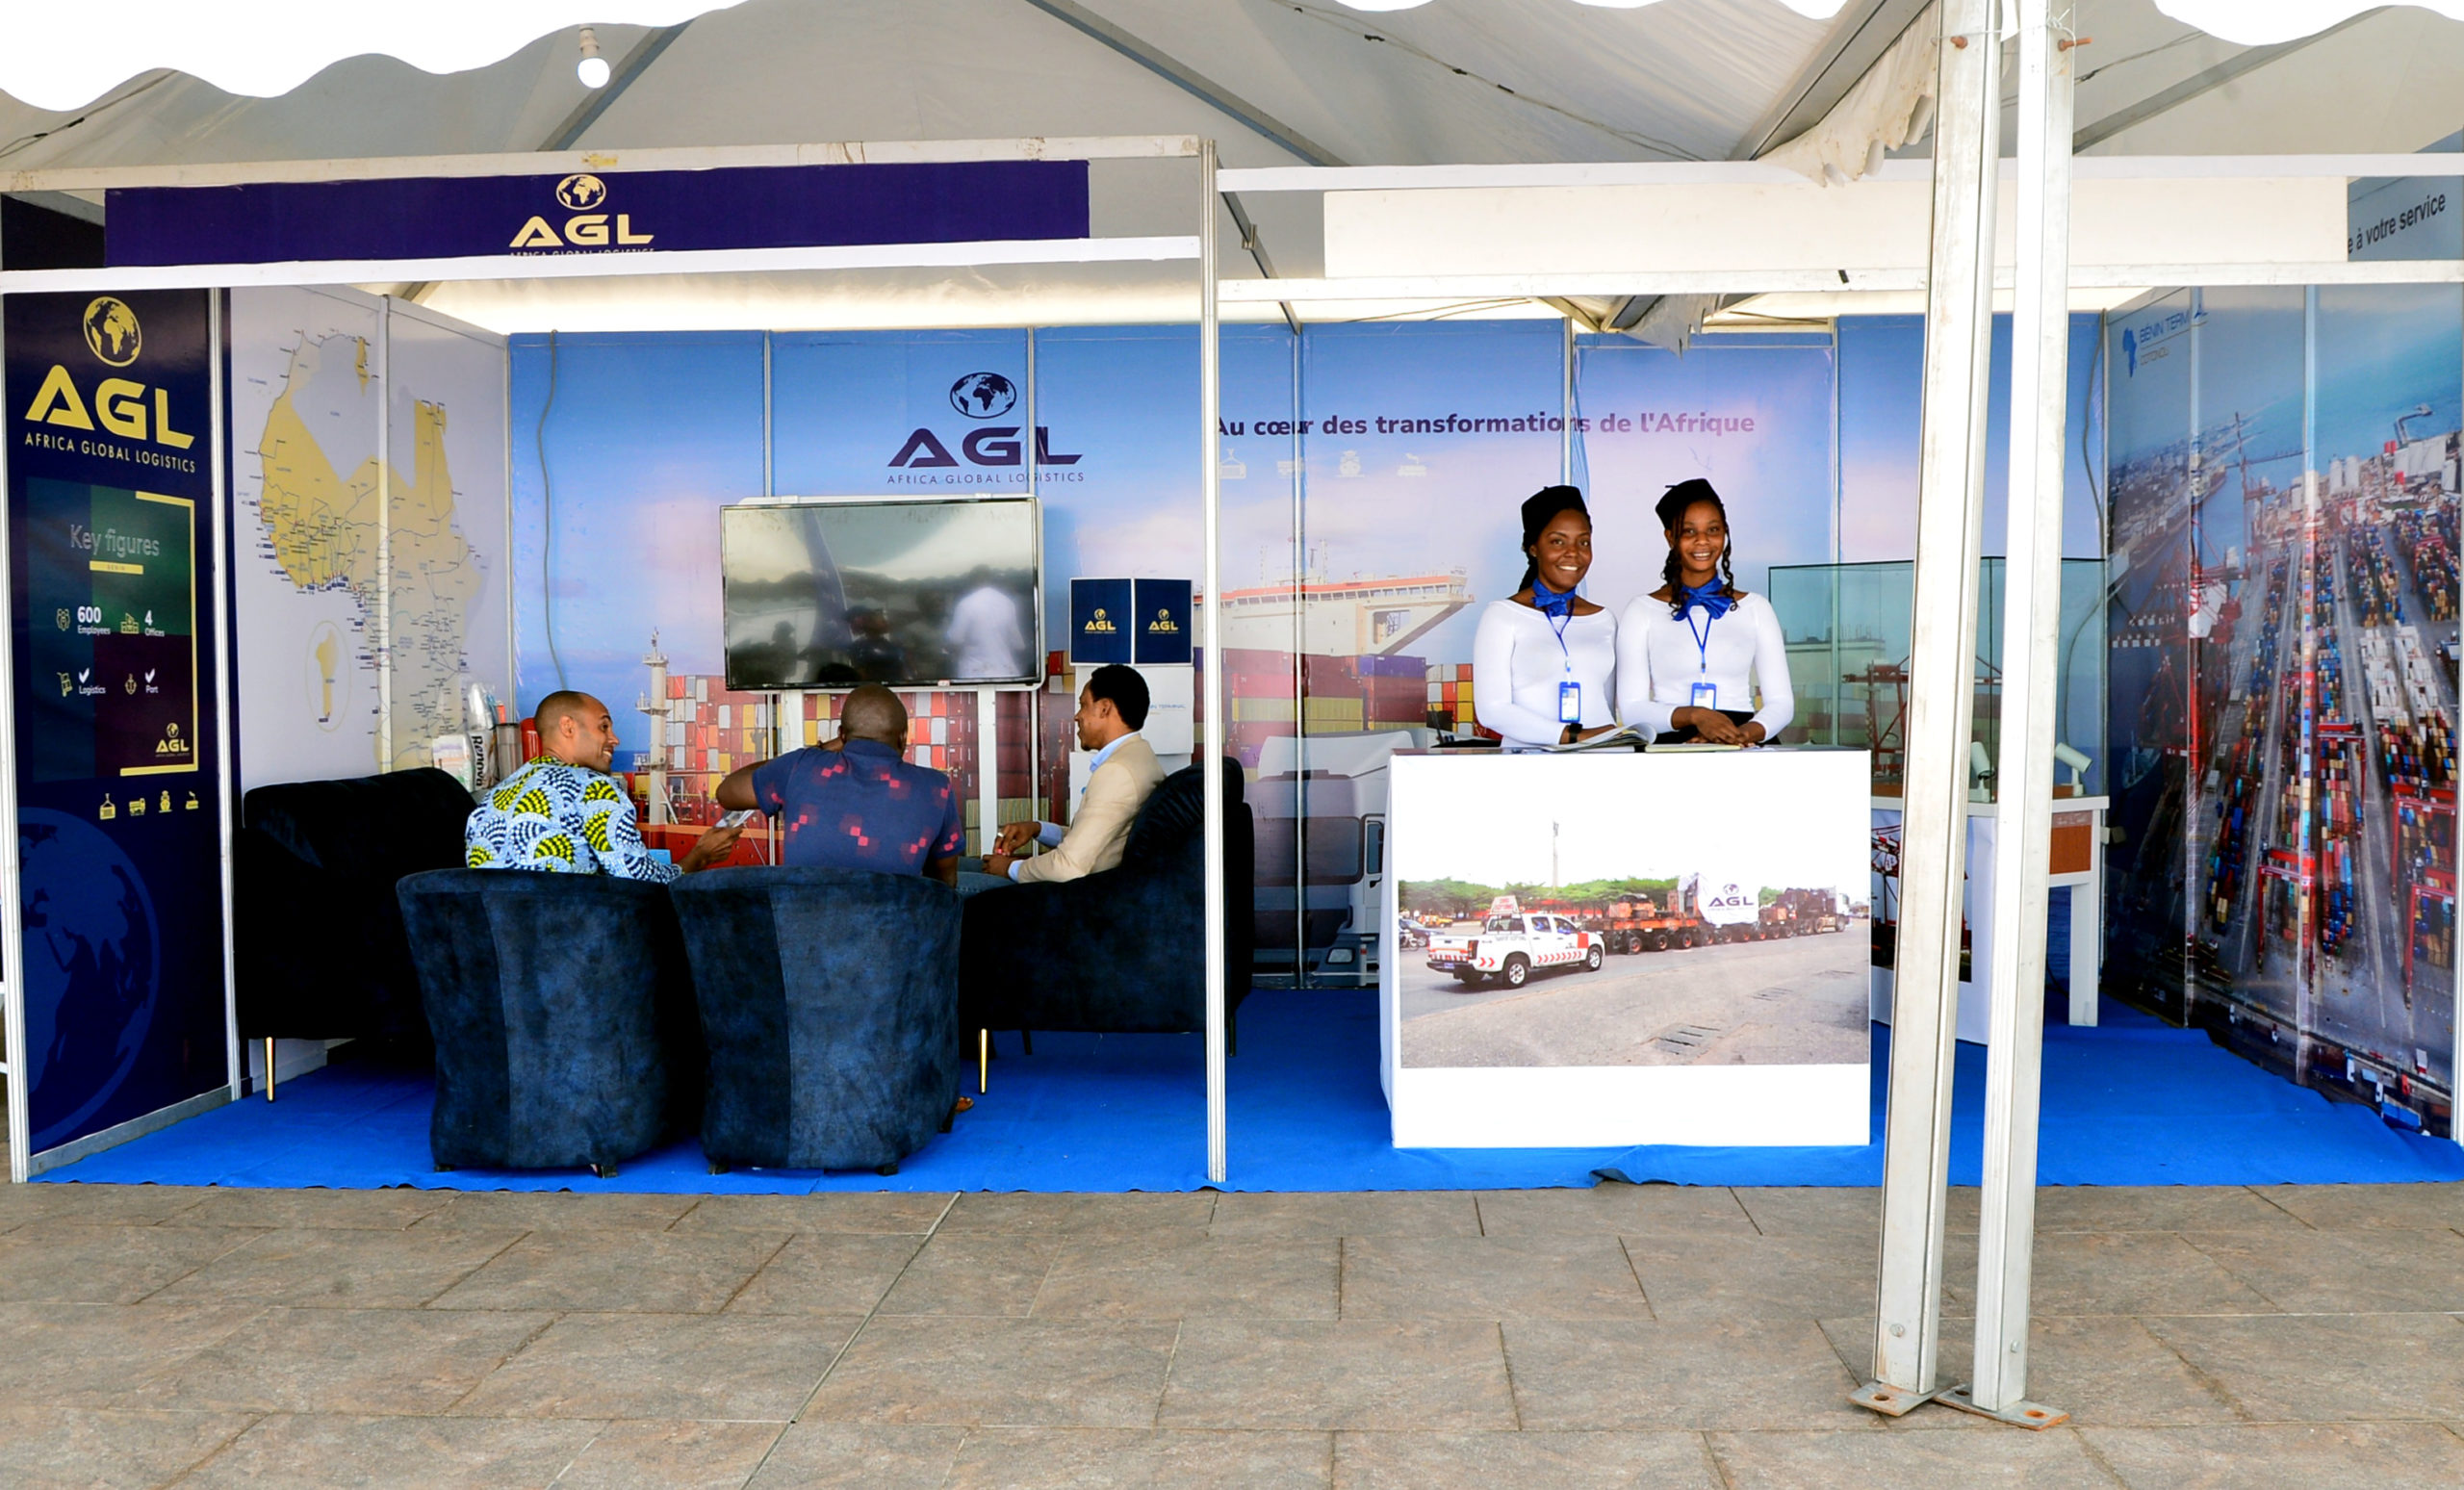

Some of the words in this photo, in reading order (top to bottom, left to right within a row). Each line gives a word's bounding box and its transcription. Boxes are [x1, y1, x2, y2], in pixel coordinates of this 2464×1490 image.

[509, 214, 654, 247] AGL
[2356, 227, 2363, 250] à
[2366, 218, 2397, 245] votre
[2400, 193, 2446, 230] service
[25, 364, 195, 450] AGL
[1219, 417, 1245, 435] Au
[1254, 421, 1314, 435] cœur
[1322, 415, 1368, 434] des
[1375, 411, 1591, 434] transformations
[1600, 413, 1632, 432] de
[1640, 412, 1756, 436] l'Afrique
[25, 432, 75, 452] AFRICA
[81, 440, 131, 462] GLOBAL
[136, 450, 196, 474] LOGISTICS
[887, 426, 1084, 469] AGL
[887, 474, 938, 484] AFRICA
[945, 473, 1001, 483] GLOBAL
[70, 524, 102, 555] Key
[105, 527, 160, 558] figures
[77, 605, 102, 624] 600
[144, 609, 153, 627] 4
[1085, 620, 1116, 631] AGL
[1148, 620, 1179, 631] AGL
[77, 624, 111, 636] Employees
[78, 684, 107, 696] Logistics
[145, 684, 159, 694] Port
[155, 738, 190, 753] AGL
[1707, 896, 1755, 908] AGL
